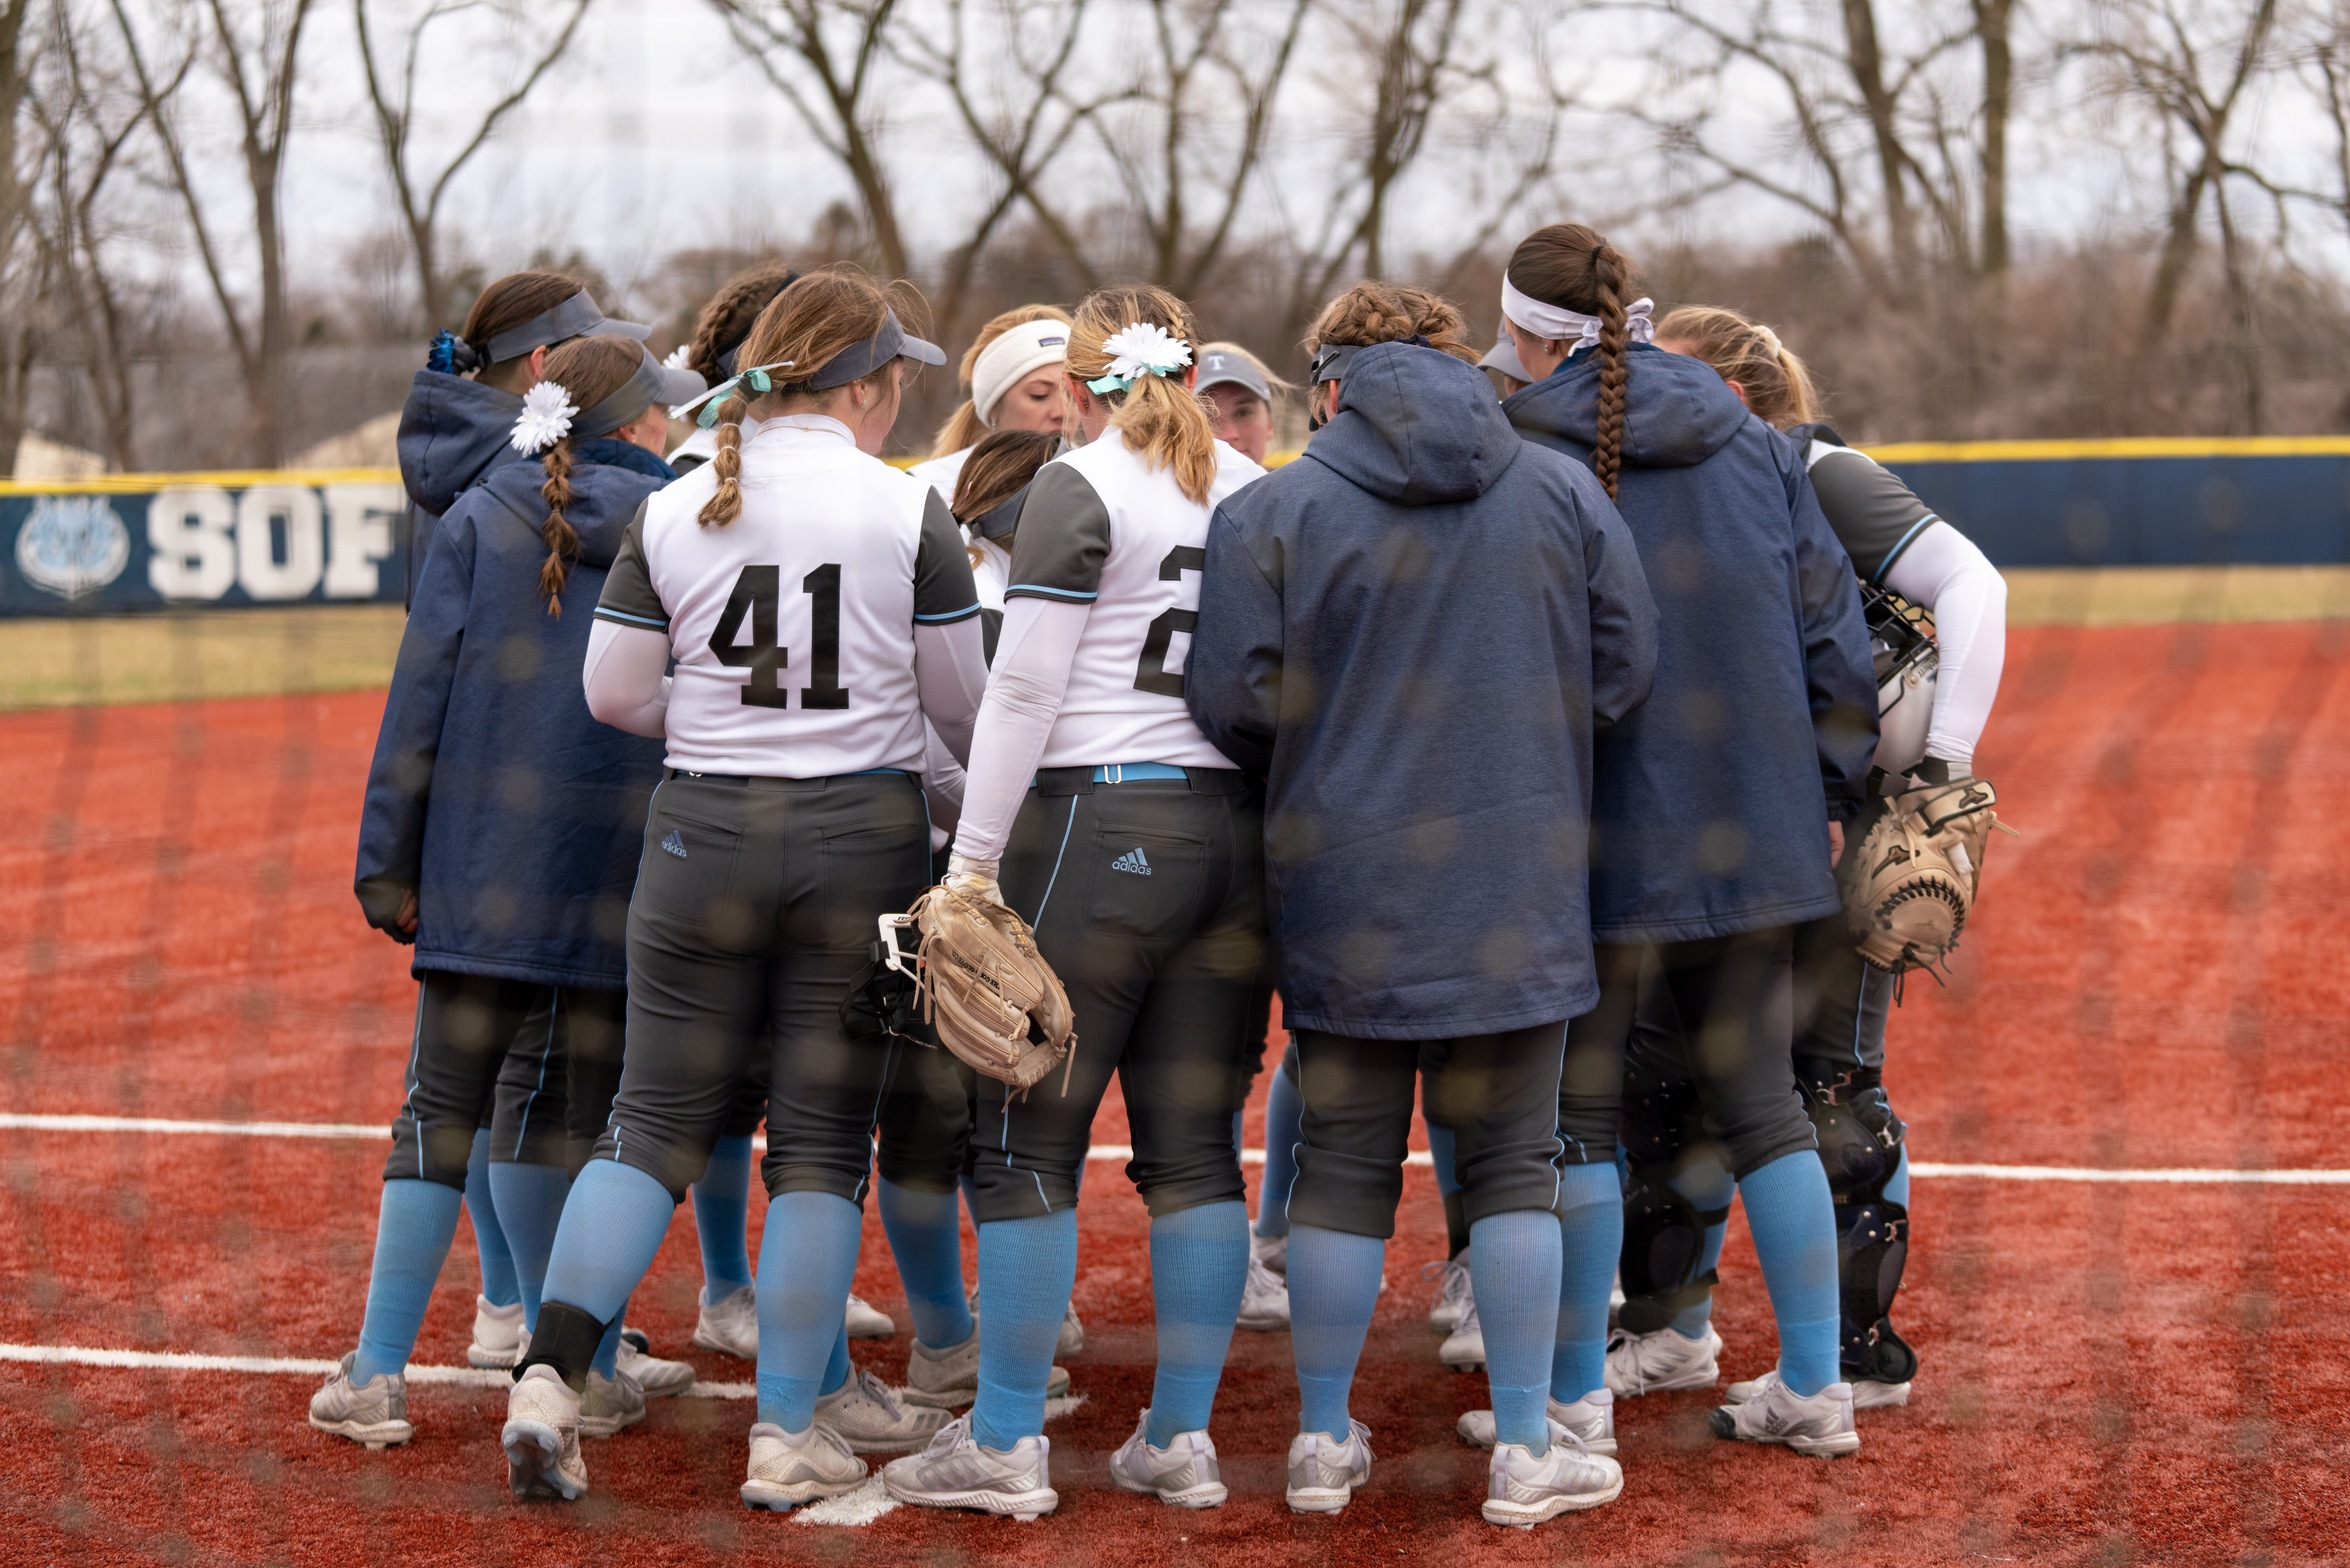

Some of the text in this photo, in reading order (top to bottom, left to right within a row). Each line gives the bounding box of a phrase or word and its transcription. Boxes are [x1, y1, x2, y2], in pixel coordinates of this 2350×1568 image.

[1207, 355, 1225, 370] T
[147, 481, 404, 600] SOF
[708, 563, 849, 709] 41
[662, 840, 687, 857] adidas
[1112, 860, 1152, 875] adidas
